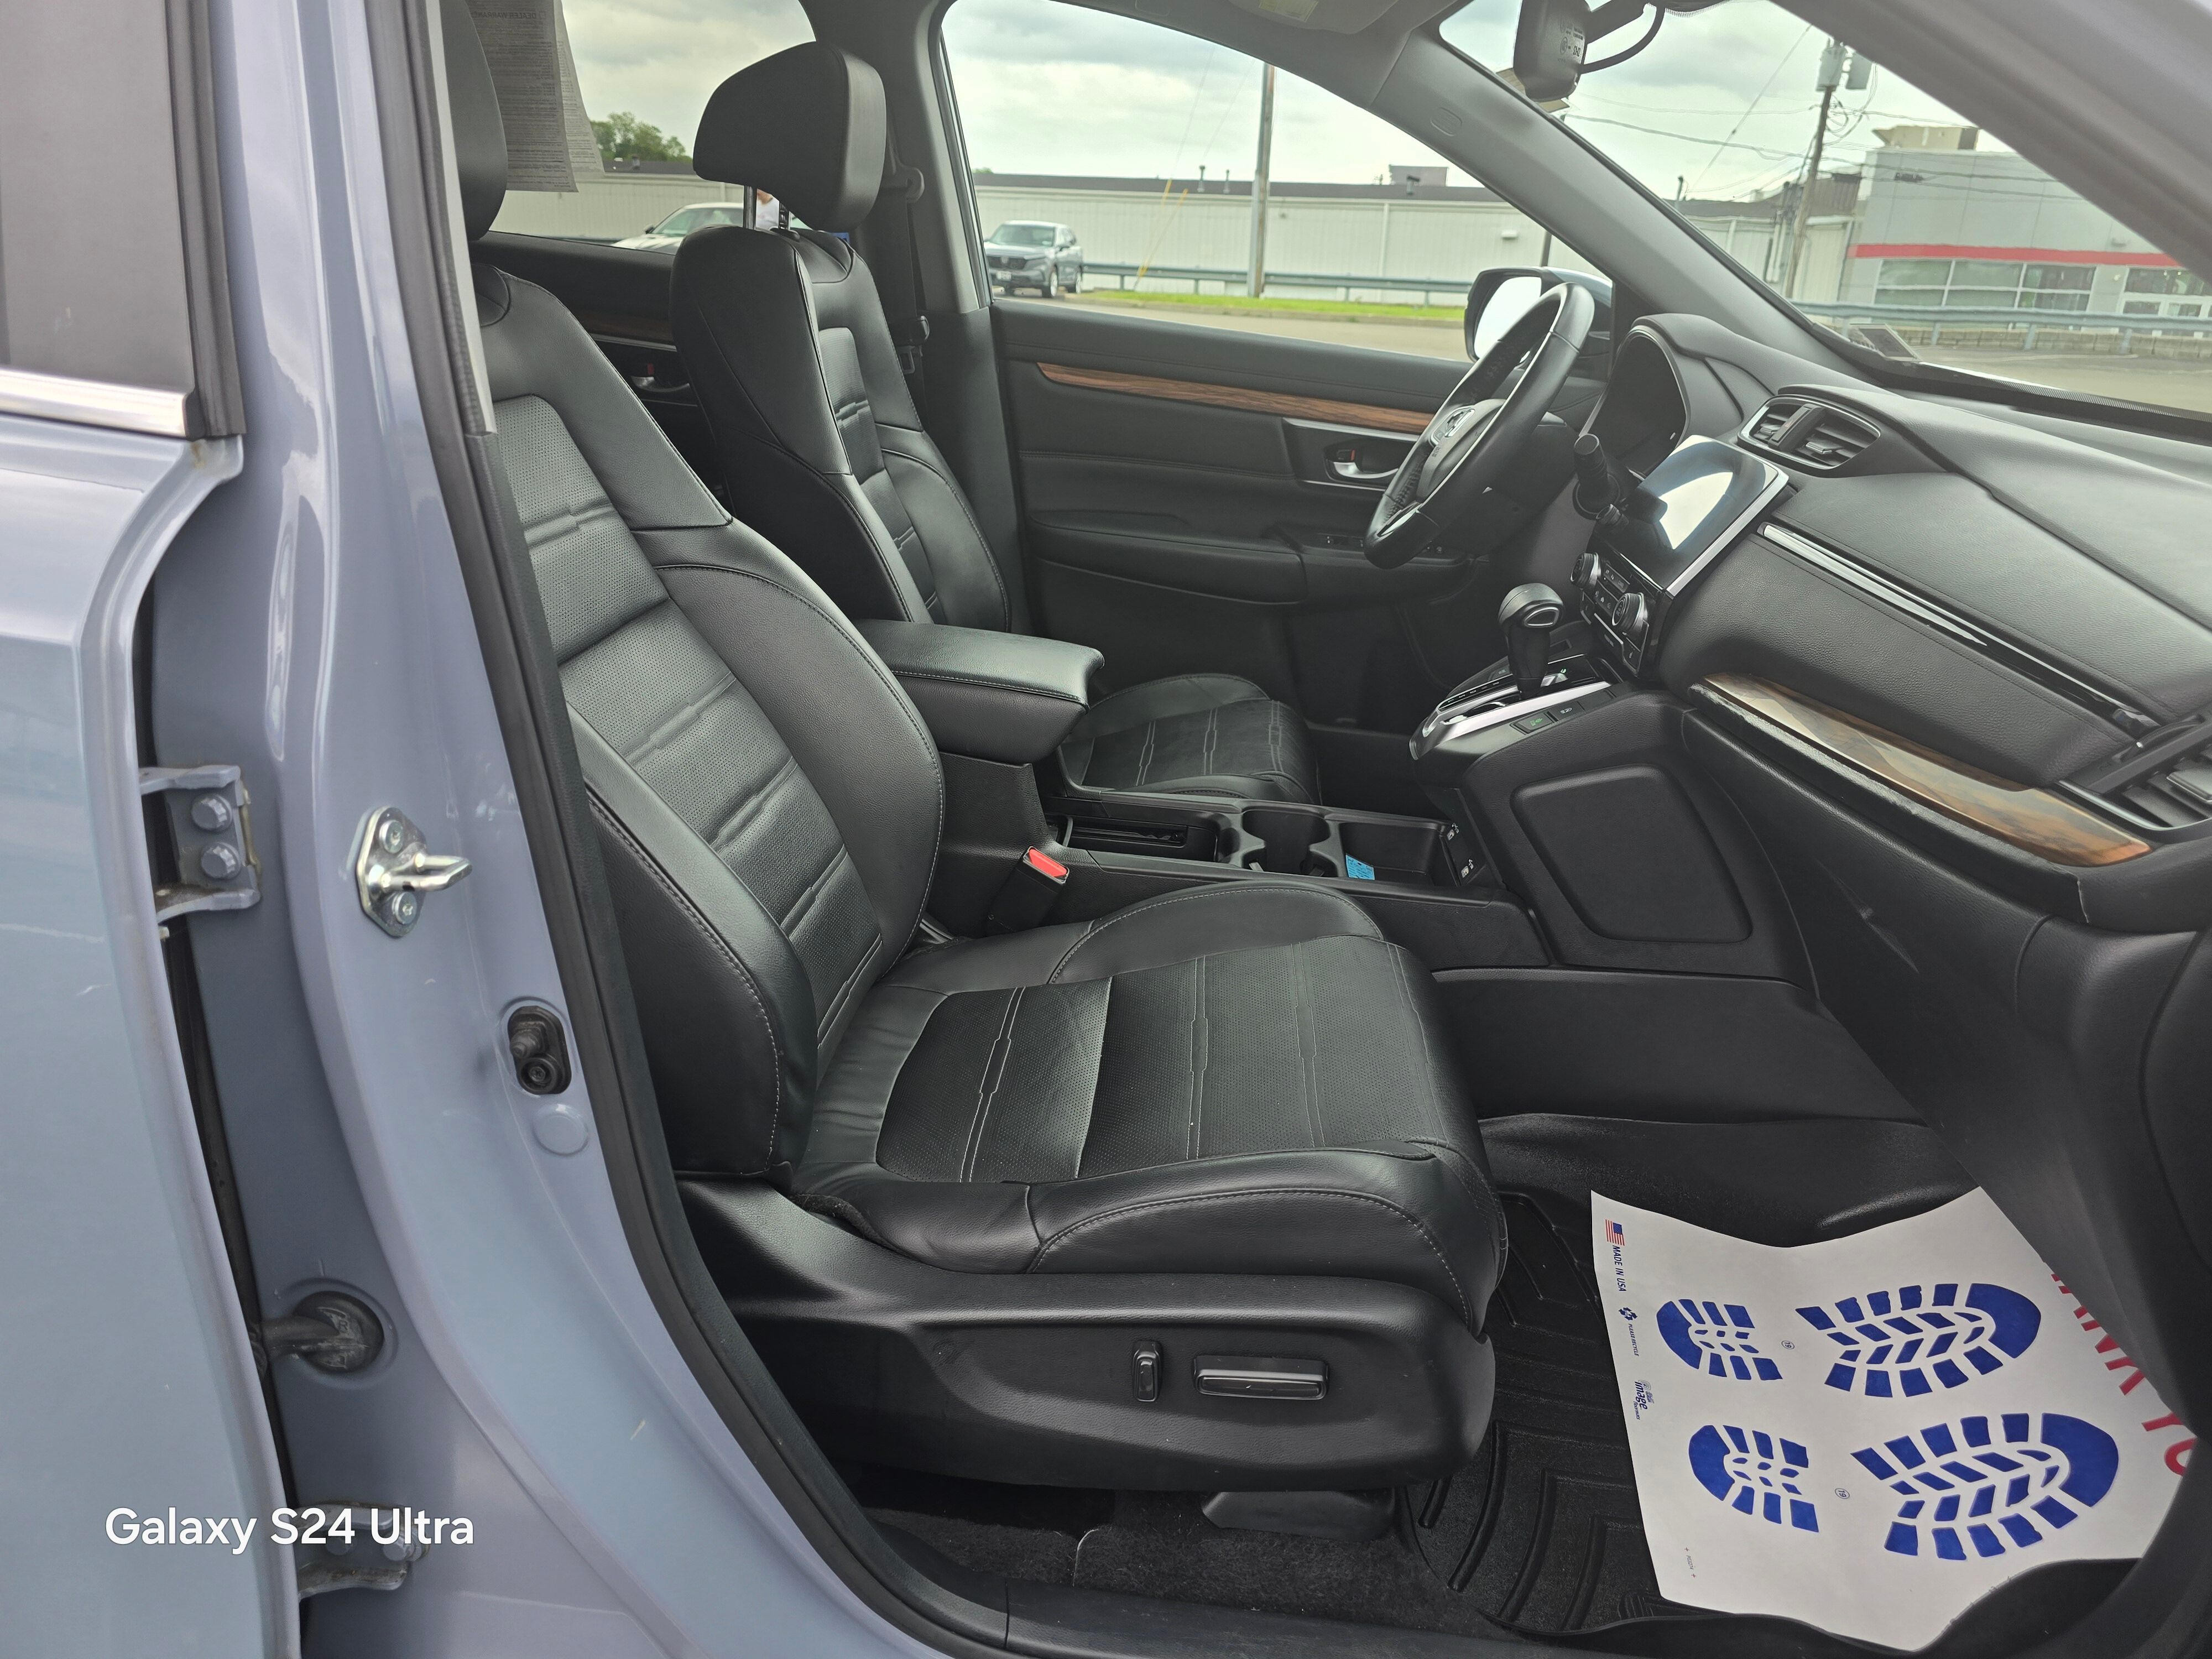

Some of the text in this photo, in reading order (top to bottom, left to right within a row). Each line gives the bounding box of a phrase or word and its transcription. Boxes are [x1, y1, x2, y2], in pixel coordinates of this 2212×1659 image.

[1612, 1245, 1626, 1292] MADE IN USA
[1634, 1381, 1648, 1410] image
